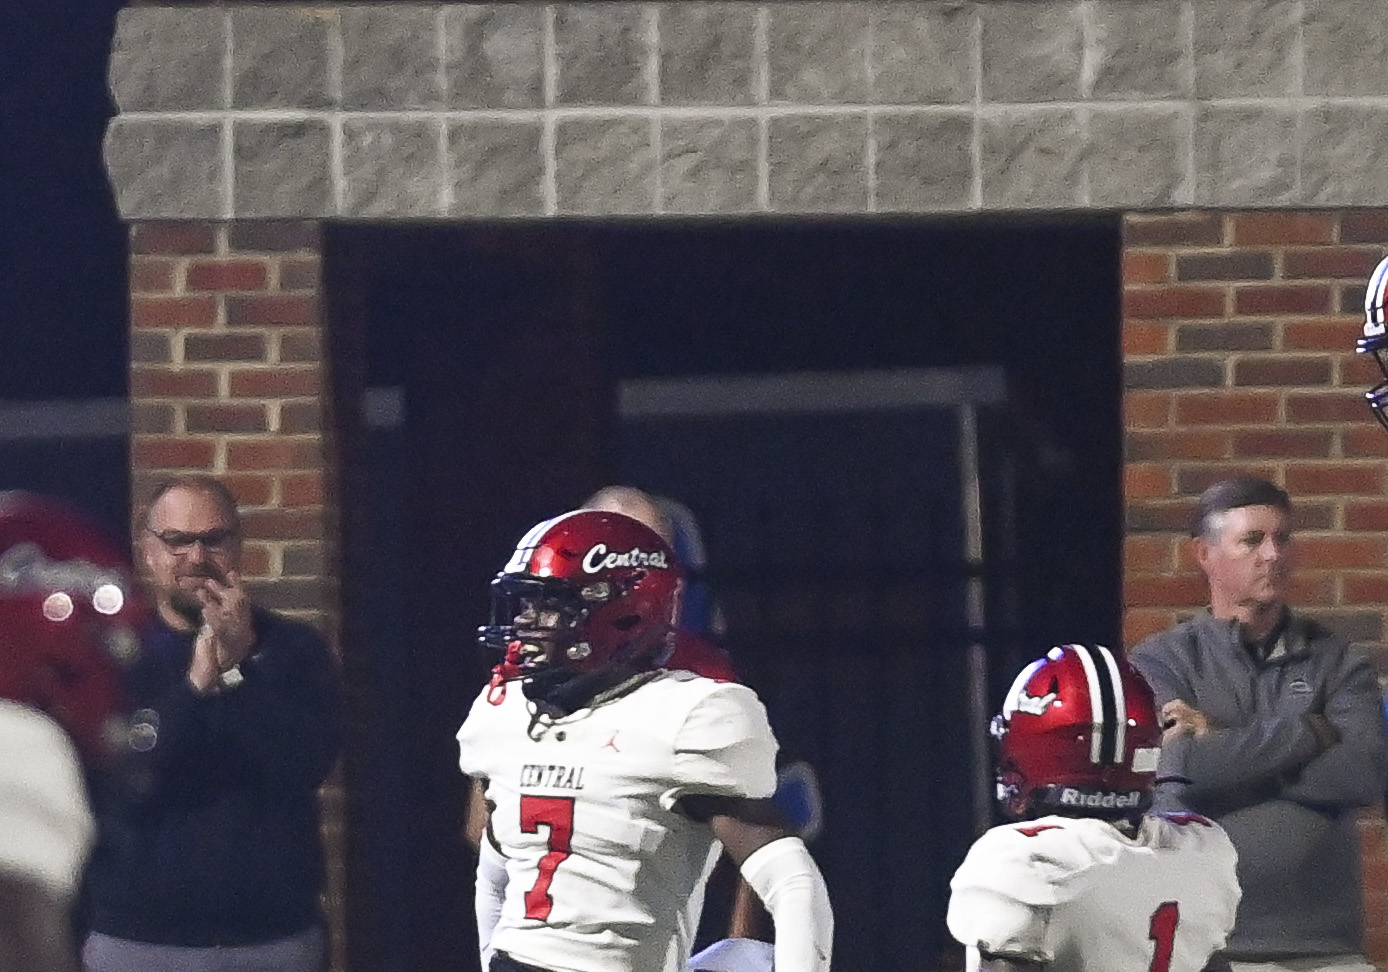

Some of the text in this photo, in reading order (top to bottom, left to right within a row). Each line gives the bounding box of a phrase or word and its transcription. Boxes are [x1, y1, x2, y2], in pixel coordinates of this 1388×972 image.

[582, 543, 669, 574] Central
[1060, 787, 1141, 809] Riddell
[519, 793, 576, 922] 7
